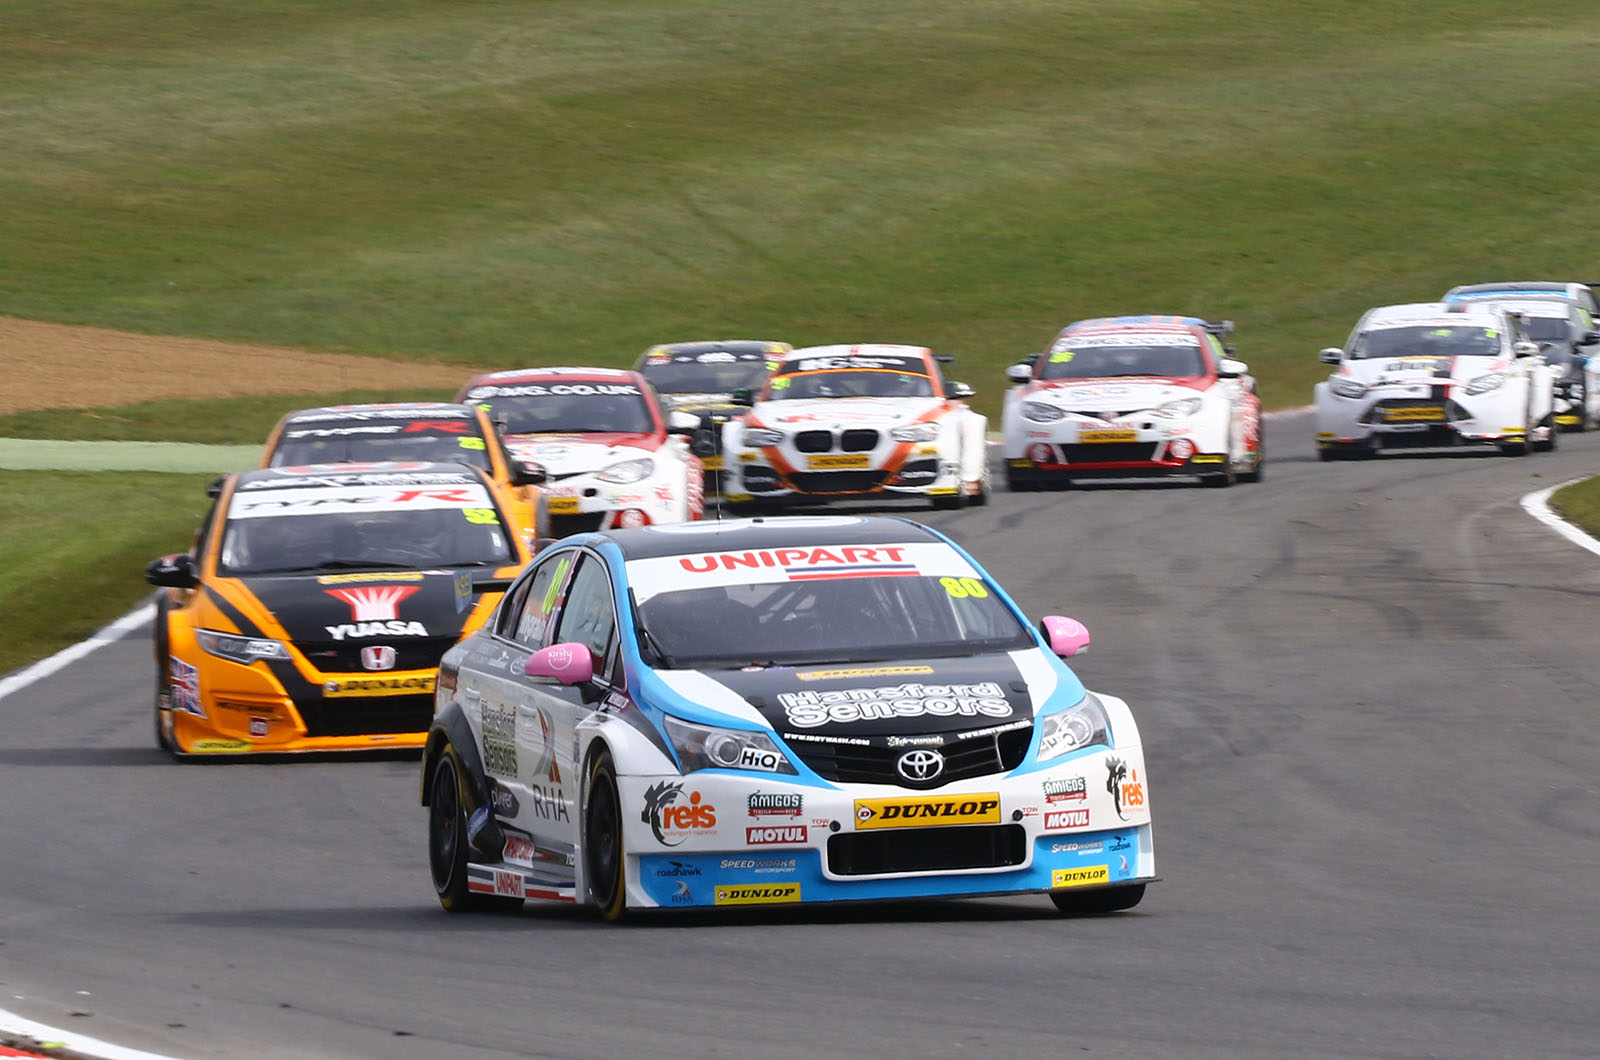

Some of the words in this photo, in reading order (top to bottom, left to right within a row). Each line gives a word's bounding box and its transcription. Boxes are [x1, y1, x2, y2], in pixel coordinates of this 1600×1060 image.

[393, 489, 479, 503] R
[680, 547, 905, 573] UNIPART
[939, 577, 989, 599] 80
[325, 620, 430, 641] YUASA
[777, 682, 1007, 709] Hansford
[786, 696, 1014, 727] Sensors
[741, 750, 777, 769] HiQ
[1045, 779, 1084, 795] AMIGOS
[1122, 768, 1144, 806] reis
[533, 784, 570, 823] RHA
[663, 791, 717, 829] reis
[750, 795, 800, 808] AMIGOS
[880, 801, 998, 819] DUNLOP
[1046, 812, 1088, 828] MOTUL
[749, 826, 806, 843] MOTUL
[657, 866, 702, 876] roadhawk
[720, 859, 796, 869] SPEEDWORKS
[496, 872, 523, 896] UNIPART
[1064, 869, 1106, 882] DUNLOP
[671, 895, 694, 903] RHA
[729, 888, 795, 899] DUNLOP
